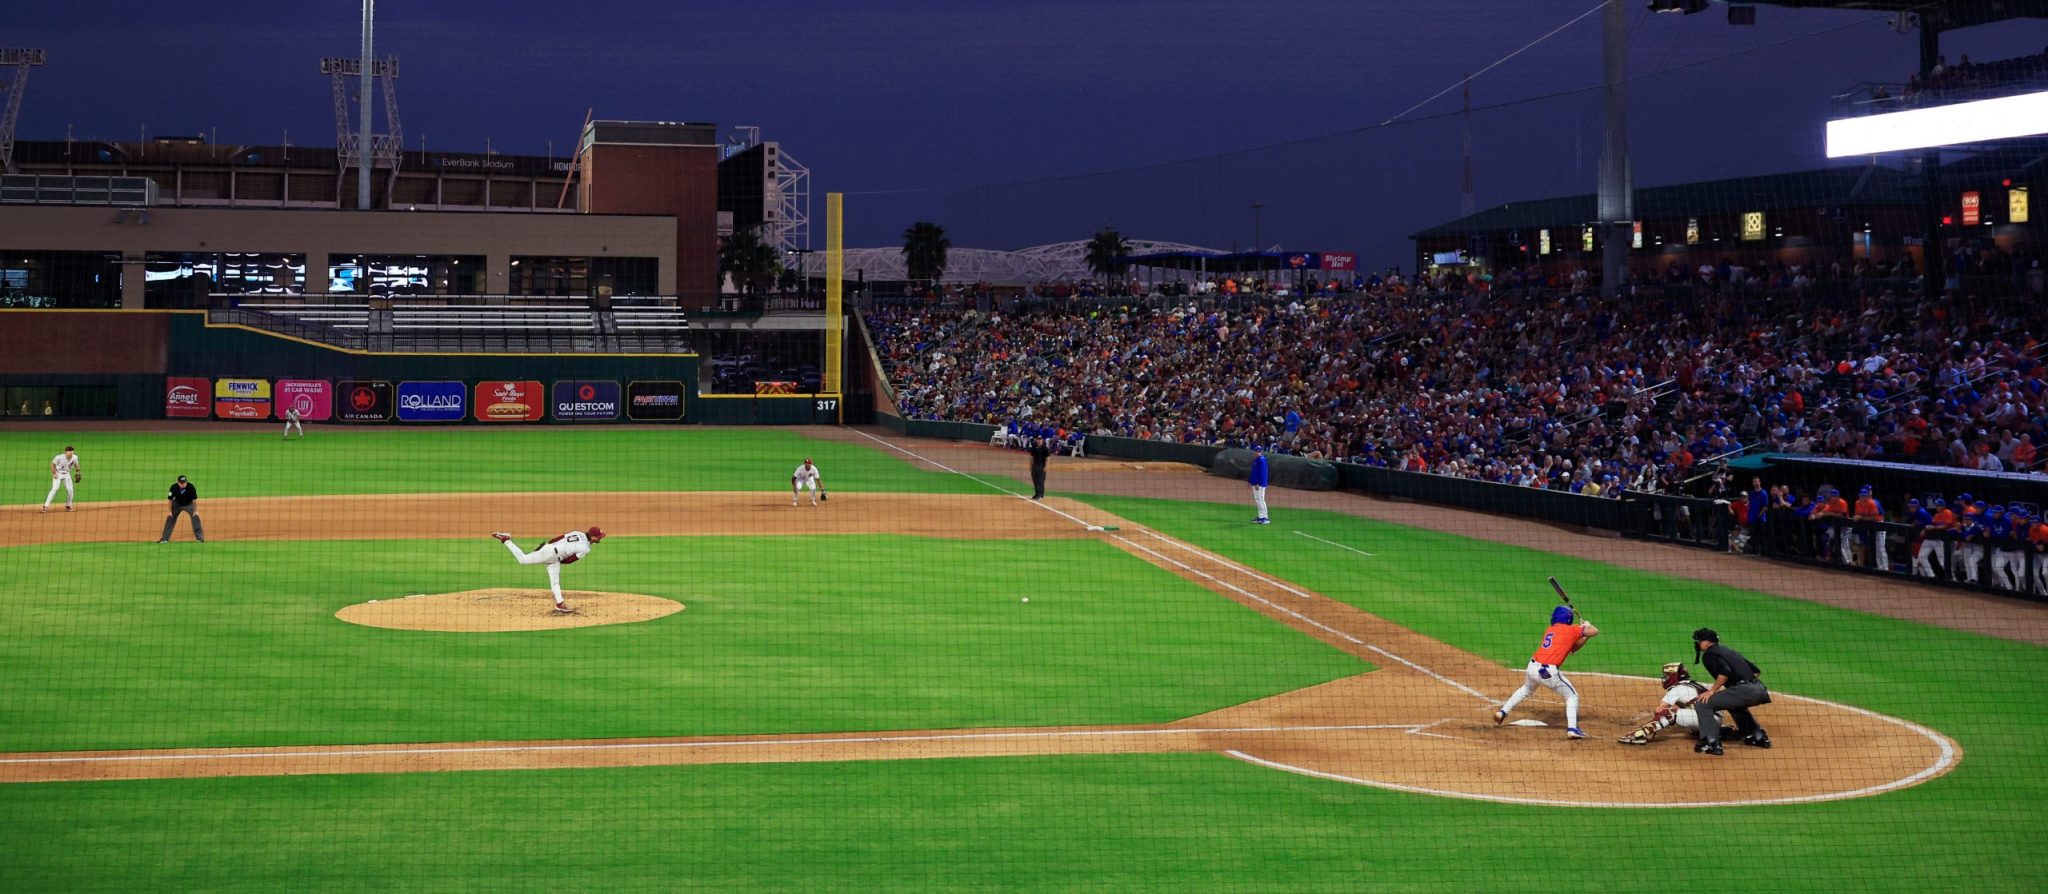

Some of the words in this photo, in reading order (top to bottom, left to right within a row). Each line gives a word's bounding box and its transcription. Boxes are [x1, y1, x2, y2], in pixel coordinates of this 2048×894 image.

[442, 157, 479, 168] EverBank
[482, 159, 514, 169] Stadium
[1325, 255, 1351, 263] Shrimp
[228, 382, 258, 391] FENWICK
[169, 391, 198, 402] Annett
[401, 394, 461, 409] ROLLAND
[558, 402, 615, 411] QUESTCOM
[817, 400, 835, 410] 317
[1541, 632, 1555, 649] 5
